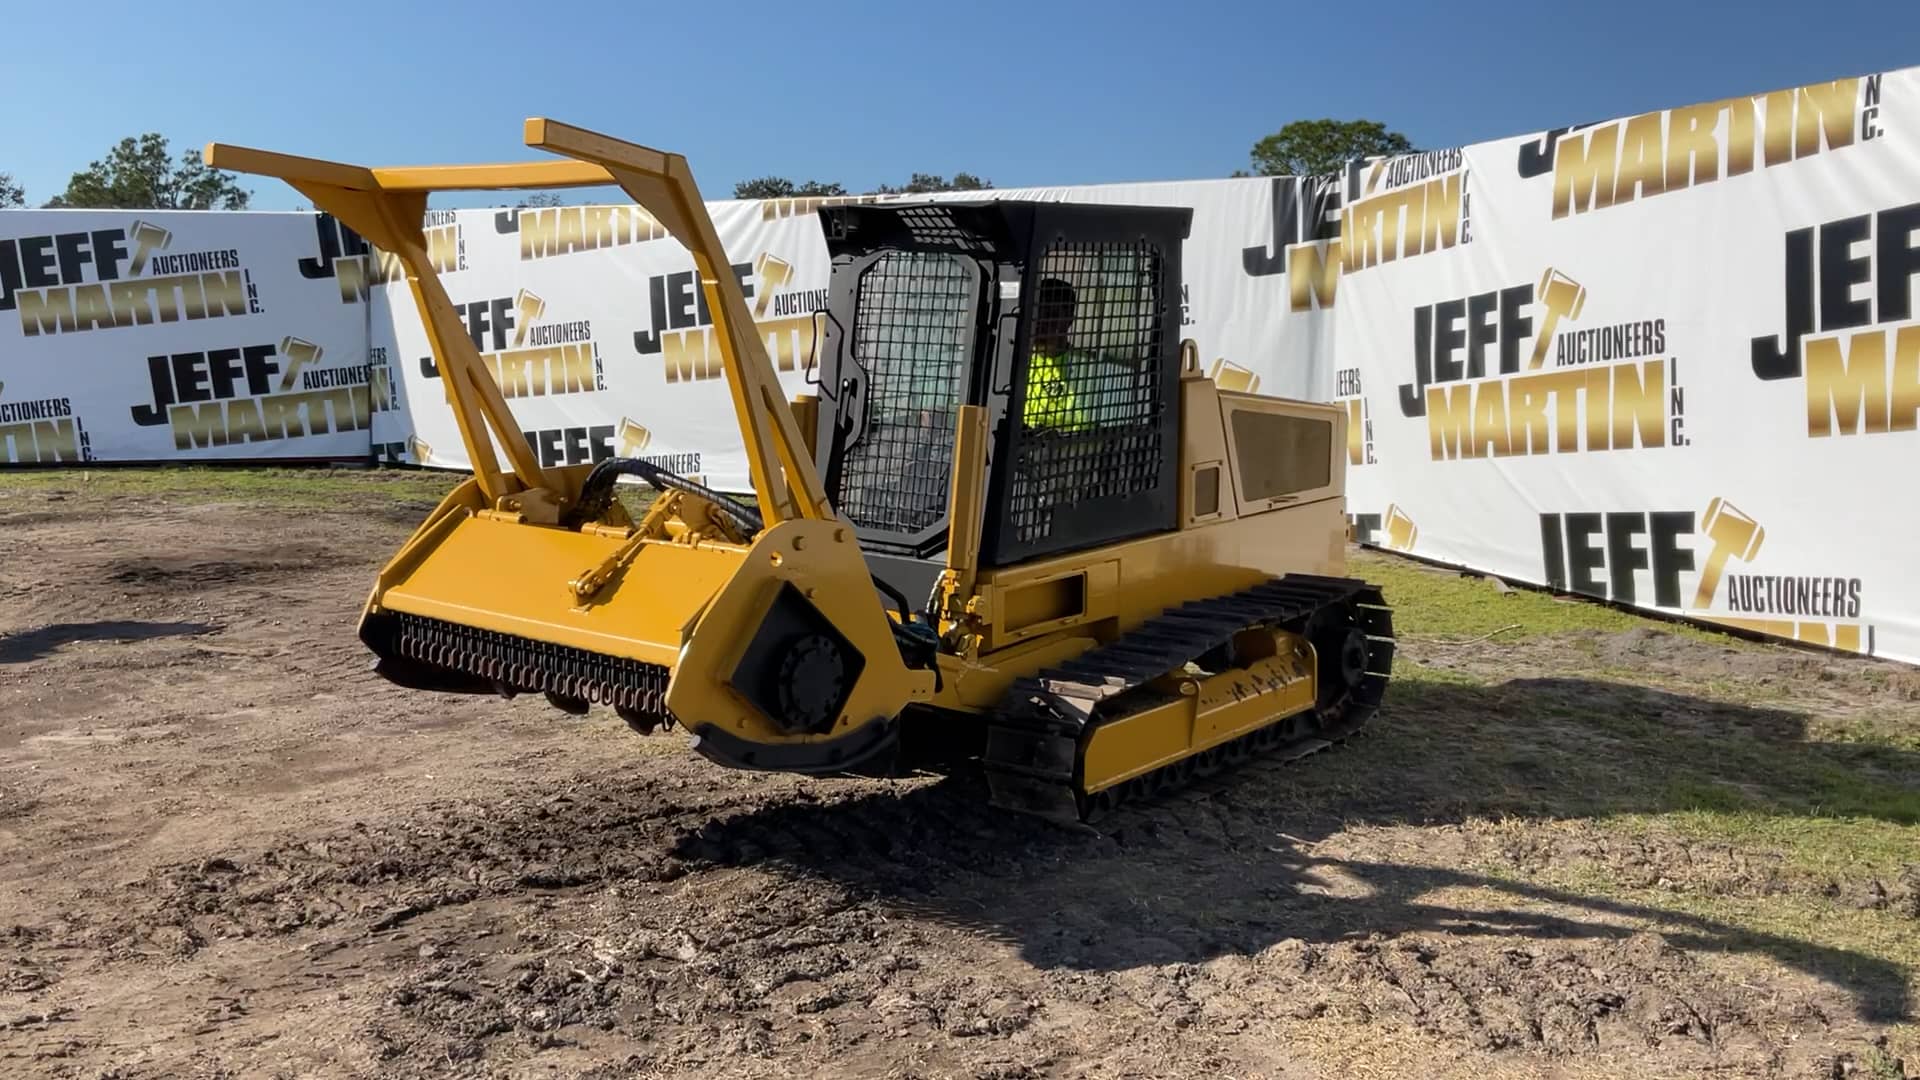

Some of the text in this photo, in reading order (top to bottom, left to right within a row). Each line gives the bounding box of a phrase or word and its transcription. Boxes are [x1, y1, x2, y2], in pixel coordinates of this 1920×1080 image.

[1552, 77, 1860, 221] MARTIN
[152, 249, 239, 276] AUCTIONEERS
[457, 223, 469, 272] INC.
[16, 270, 247, 336] MARTIN
[244, 268, 264, 314] INC.
[530, 320, 591, 346] AUCTIONEERS
[1399, 283, 1534, 418] JEFF
[1556, 318, 1666, 367] AUCTIONEERS
[130, 344, 279, 426] JEFF
[593, 341, 608, 391] INC.
[0, 397, 72, 423] CTIONEERS
[1426, 360, 1666, 461] MARTIN
[1671, 357, 1691, 447] INC.
[76, 416, 98, 462] INC.
[1364, 396, 1378, 465] INC.
[1728, 575, 1862, 618] AUCTIONEERS
